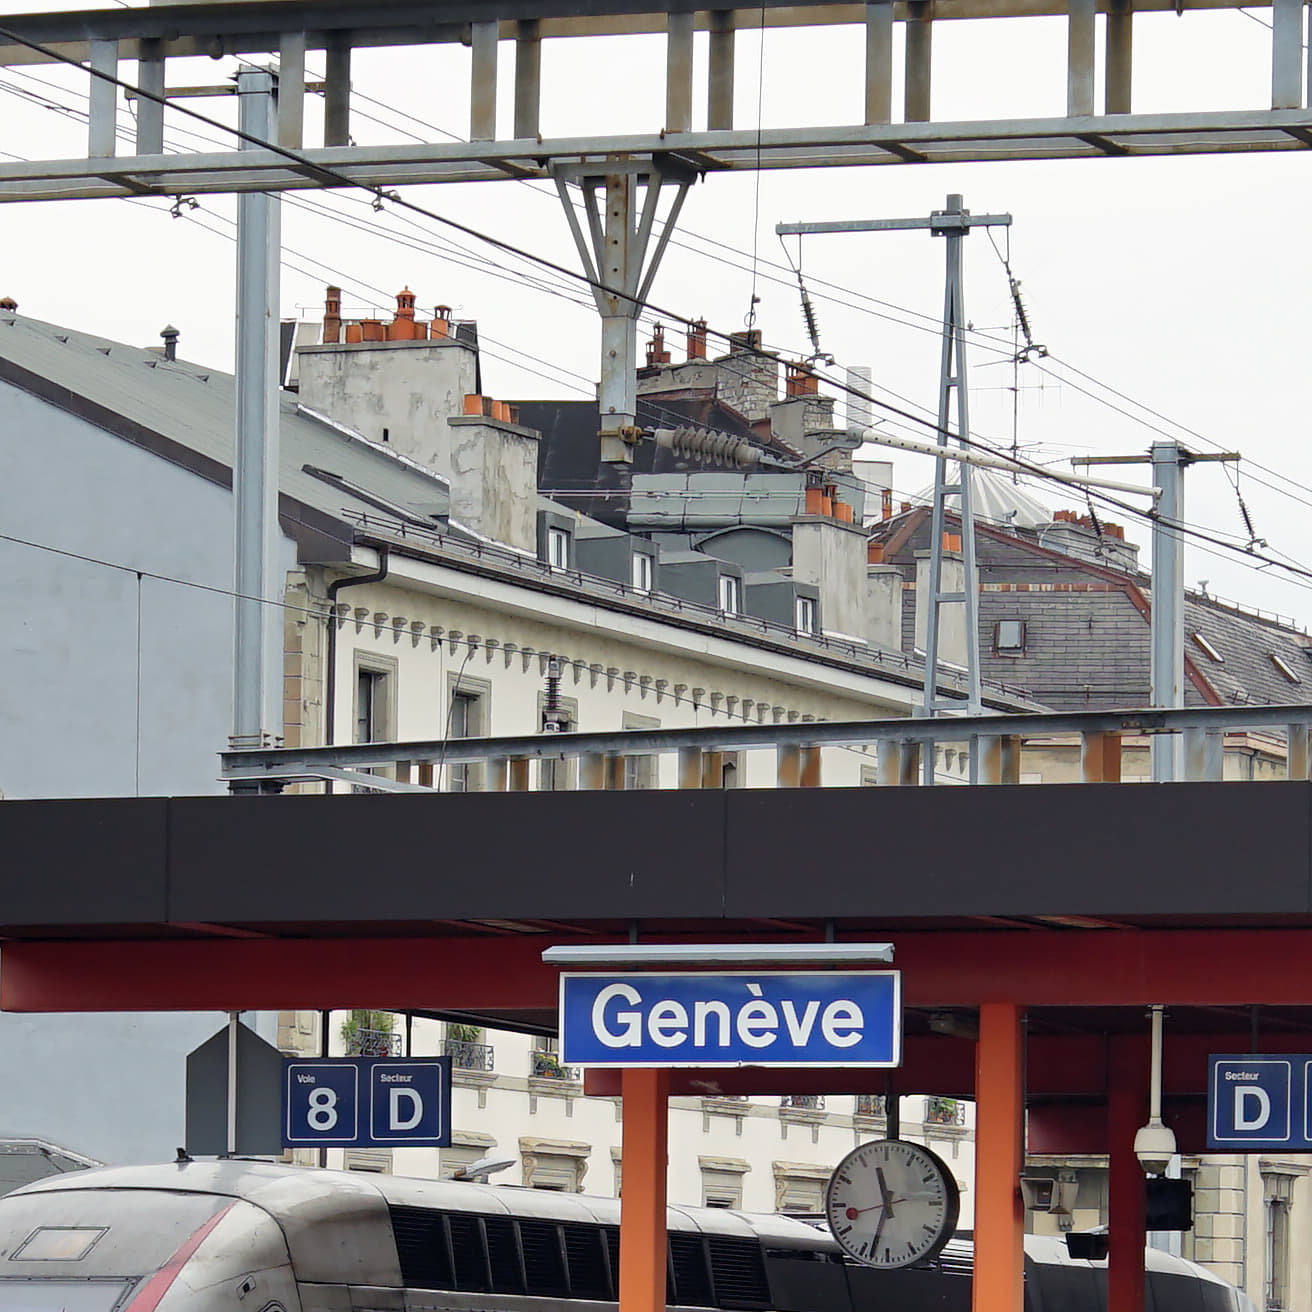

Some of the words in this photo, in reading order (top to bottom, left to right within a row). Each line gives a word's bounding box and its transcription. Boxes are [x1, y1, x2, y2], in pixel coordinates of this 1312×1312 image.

[591, 982, 865, 1049] Genève
[380, 1073, 413, 1083] Secteur
[1225, 1071, 1259, 1081] Secteur
[307, 1087, 338, 1131] 8
[389, 1087, 424, 1130] D
[1233, 1085, 1271, 1131] D
